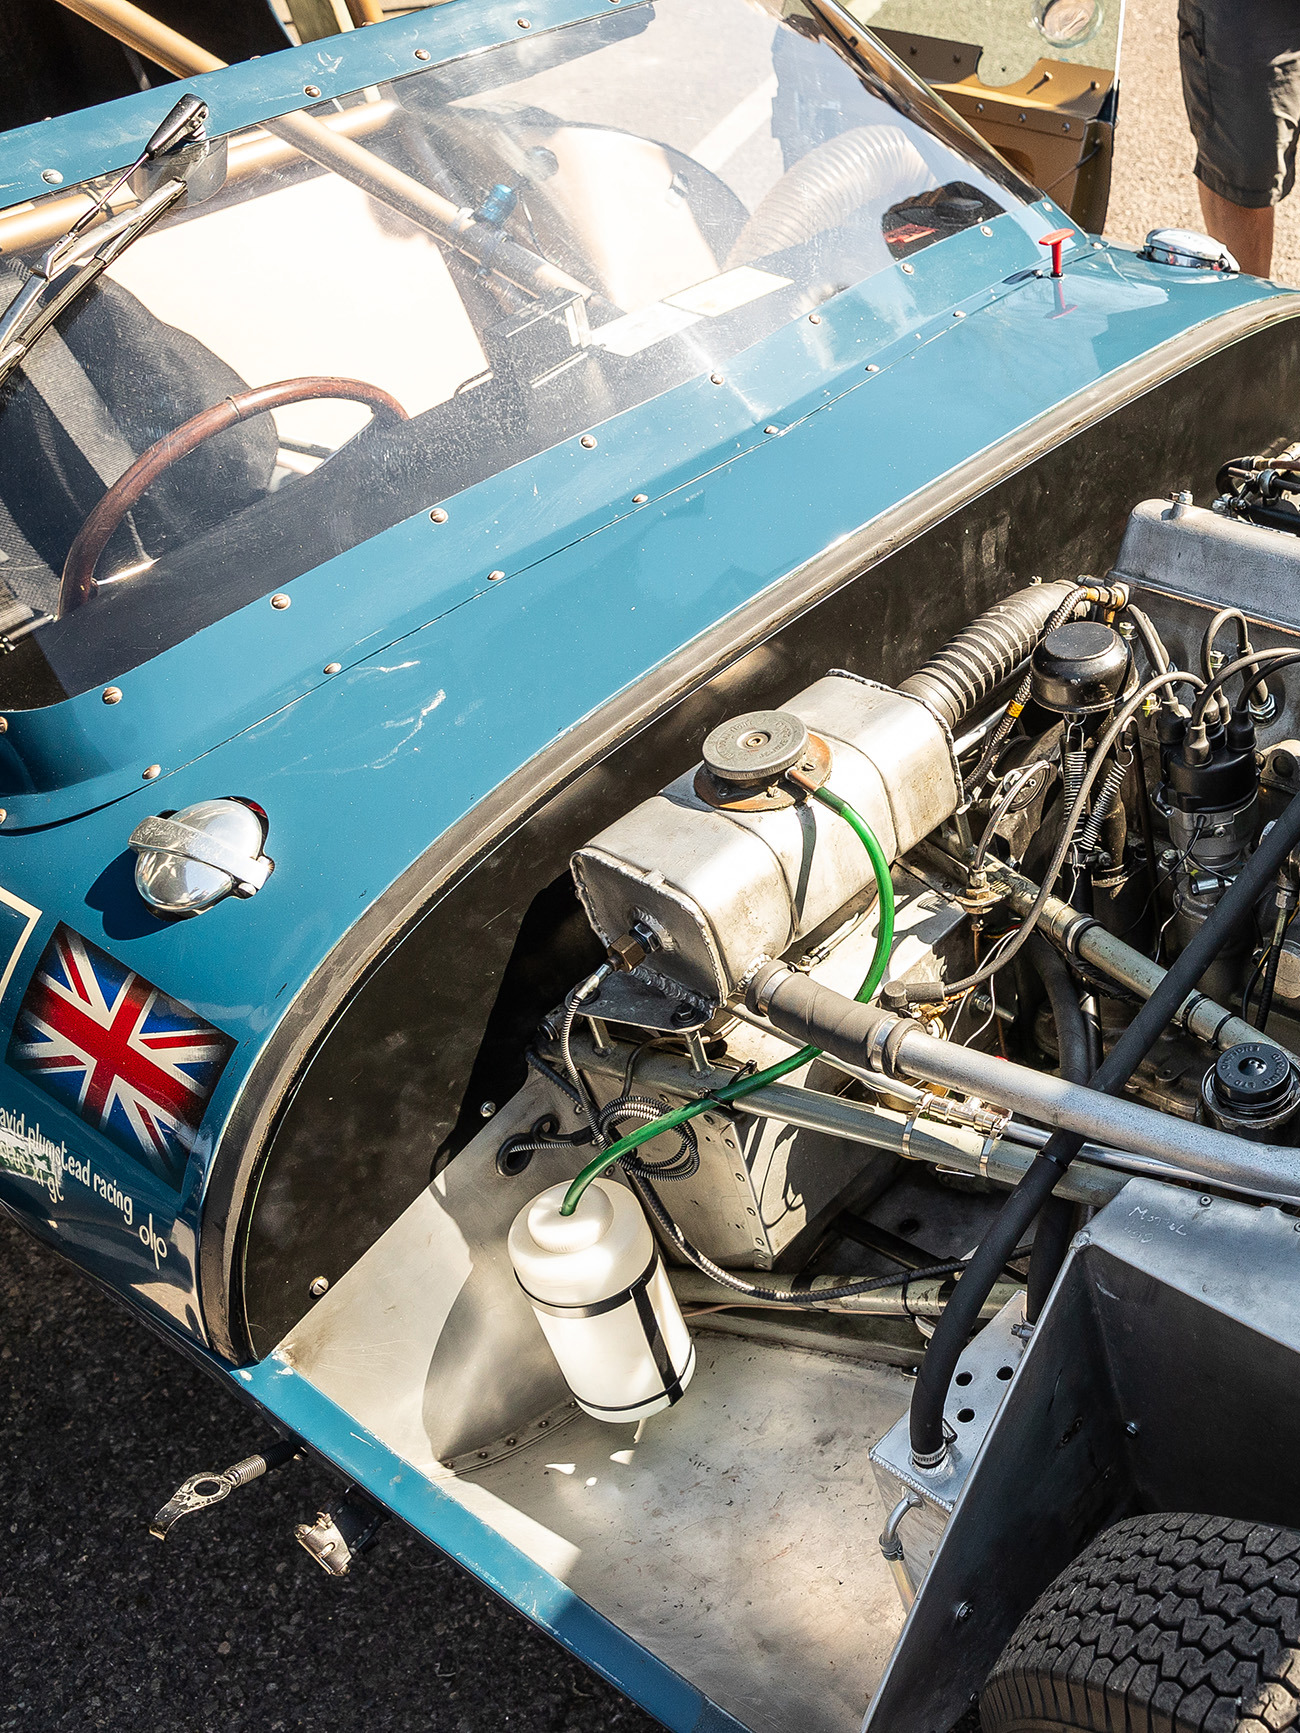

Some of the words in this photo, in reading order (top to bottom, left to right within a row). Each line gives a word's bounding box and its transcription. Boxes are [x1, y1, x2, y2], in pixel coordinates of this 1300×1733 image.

[0, 1106, 25, 1139] avid
[28, 1123, 91, 1187] plumstead
[93, 1173, 133, 1226] racing
